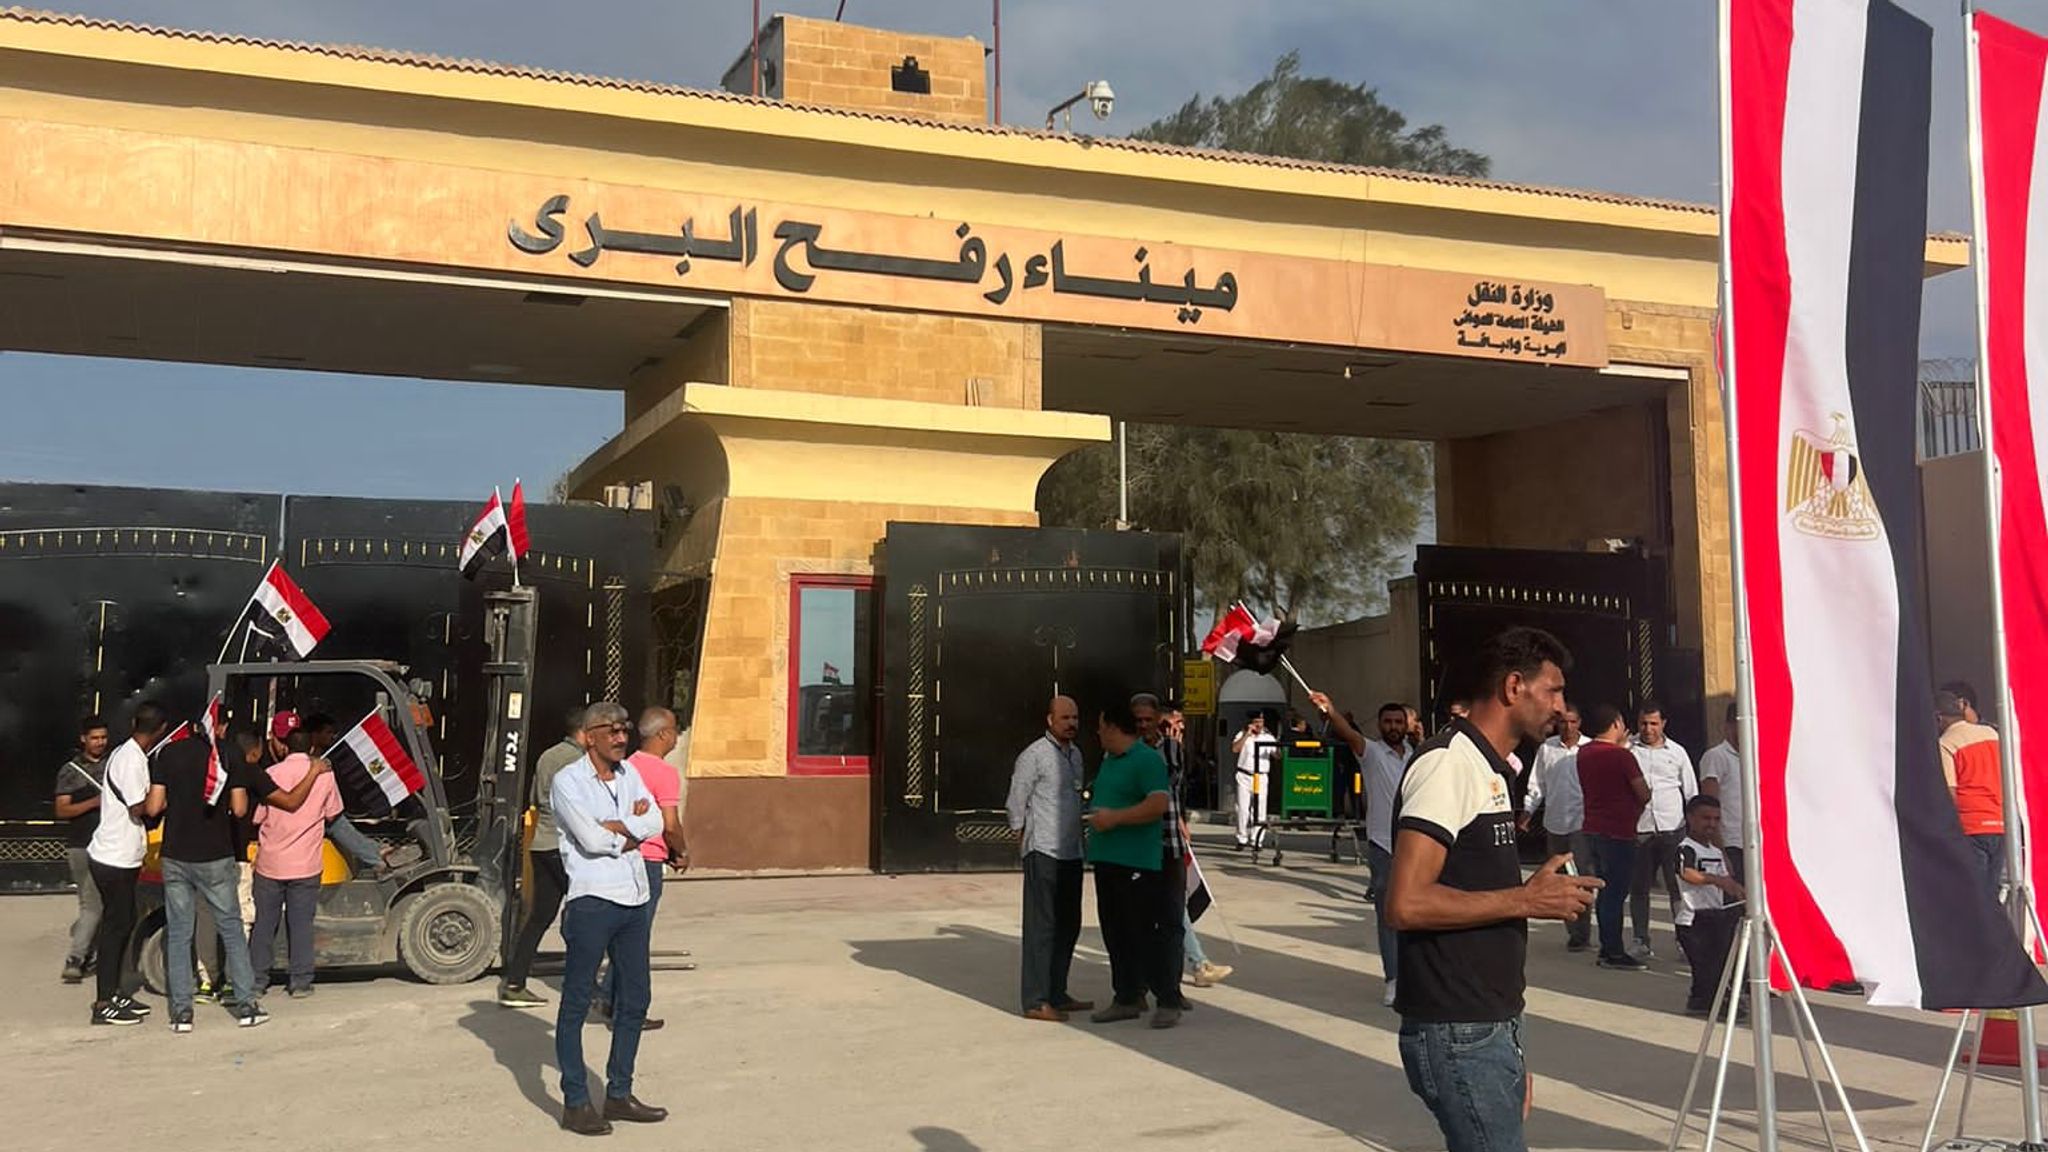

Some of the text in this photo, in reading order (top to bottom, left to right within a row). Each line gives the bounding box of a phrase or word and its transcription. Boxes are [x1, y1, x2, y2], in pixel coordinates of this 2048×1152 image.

[773, 222, 1013, 305] رفح
[1023, 238, 1238, 324] ميناء
[1468, 281, 1552, 313] وزارة النقل
[504, 731, 519, 772] TCM
